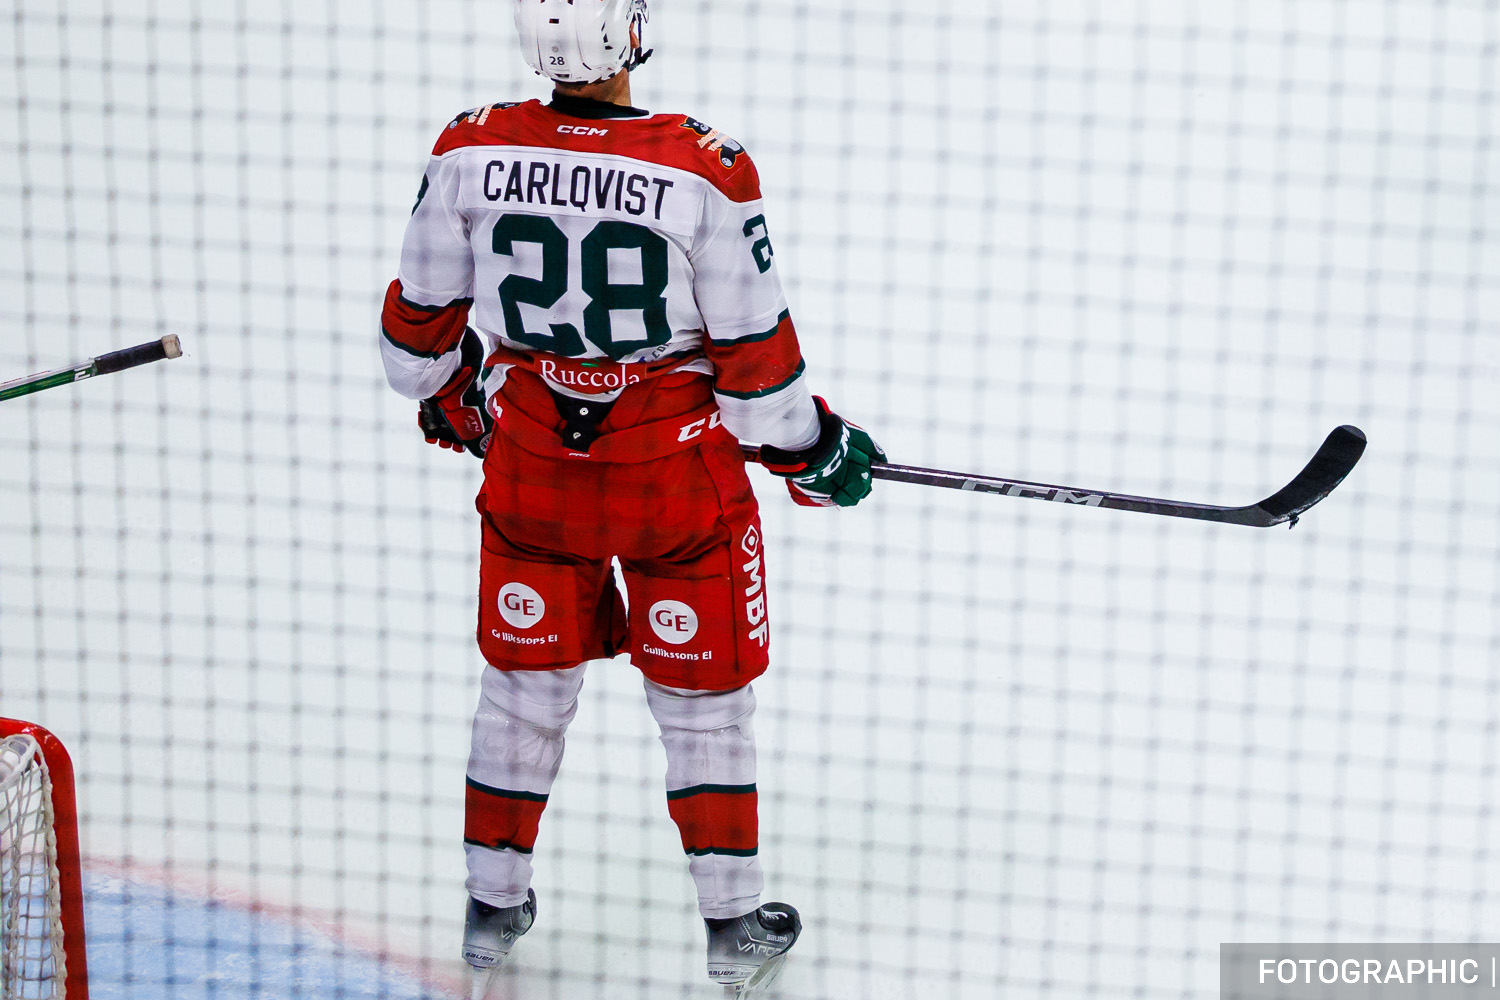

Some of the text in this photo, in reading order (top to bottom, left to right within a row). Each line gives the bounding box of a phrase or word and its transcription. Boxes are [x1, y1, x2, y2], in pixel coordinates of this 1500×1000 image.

[549, 56, 565, 66] 28
[556, 125, 609, 137] CCM
[483, 159, 674, 221] CARLQVIST
[492, 213, 673, 363] 28
[539, 360, 640, 388] Ruccola
[792, 424, 850, 484] CCM
[961, 478, 1104, 507] CCM
[503, 591, 536, 616] GE
[655, 609, 688, 633] GE
[643, 643, 699, 661] Gullikssons
